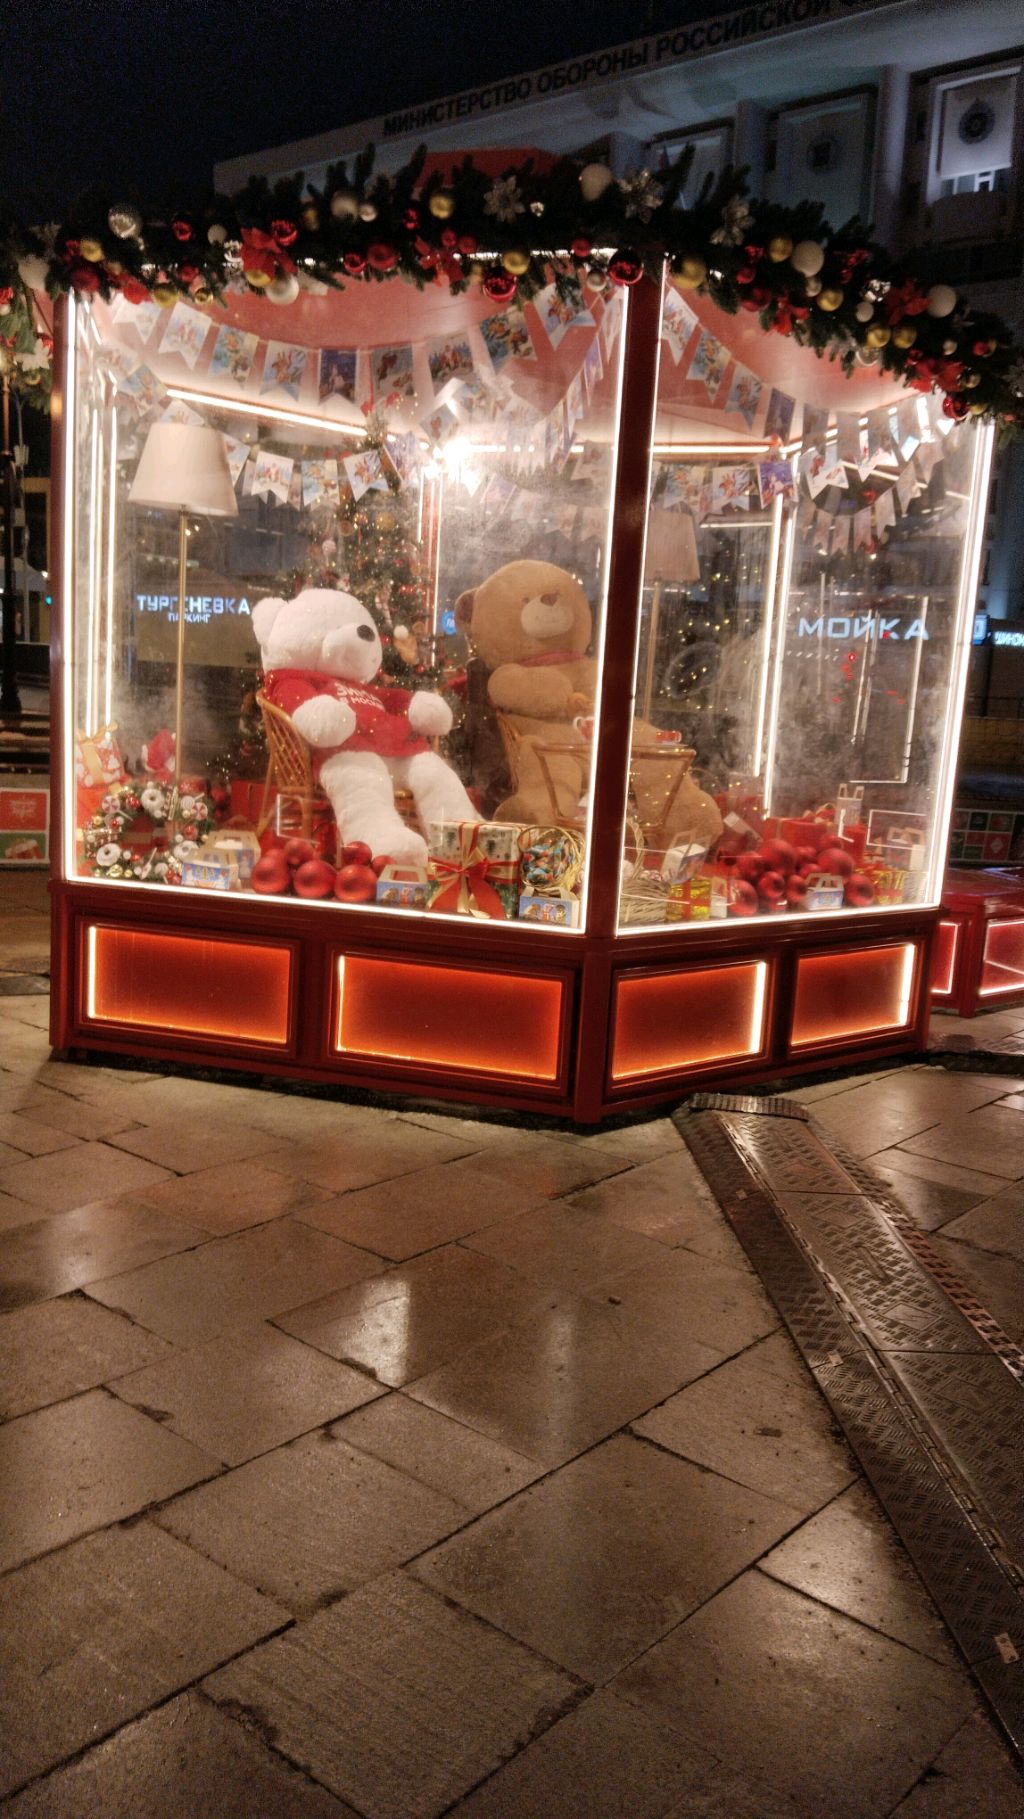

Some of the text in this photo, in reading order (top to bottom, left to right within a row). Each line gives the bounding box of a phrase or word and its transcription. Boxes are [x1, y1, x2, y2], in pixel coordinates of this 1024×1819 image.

[383, 77, 530, 135] МИНИСТЕРСТВО
[537, 43, 648, 92] ОБОРОНЫ
[798, 616, 929, 640] МОЙКА
